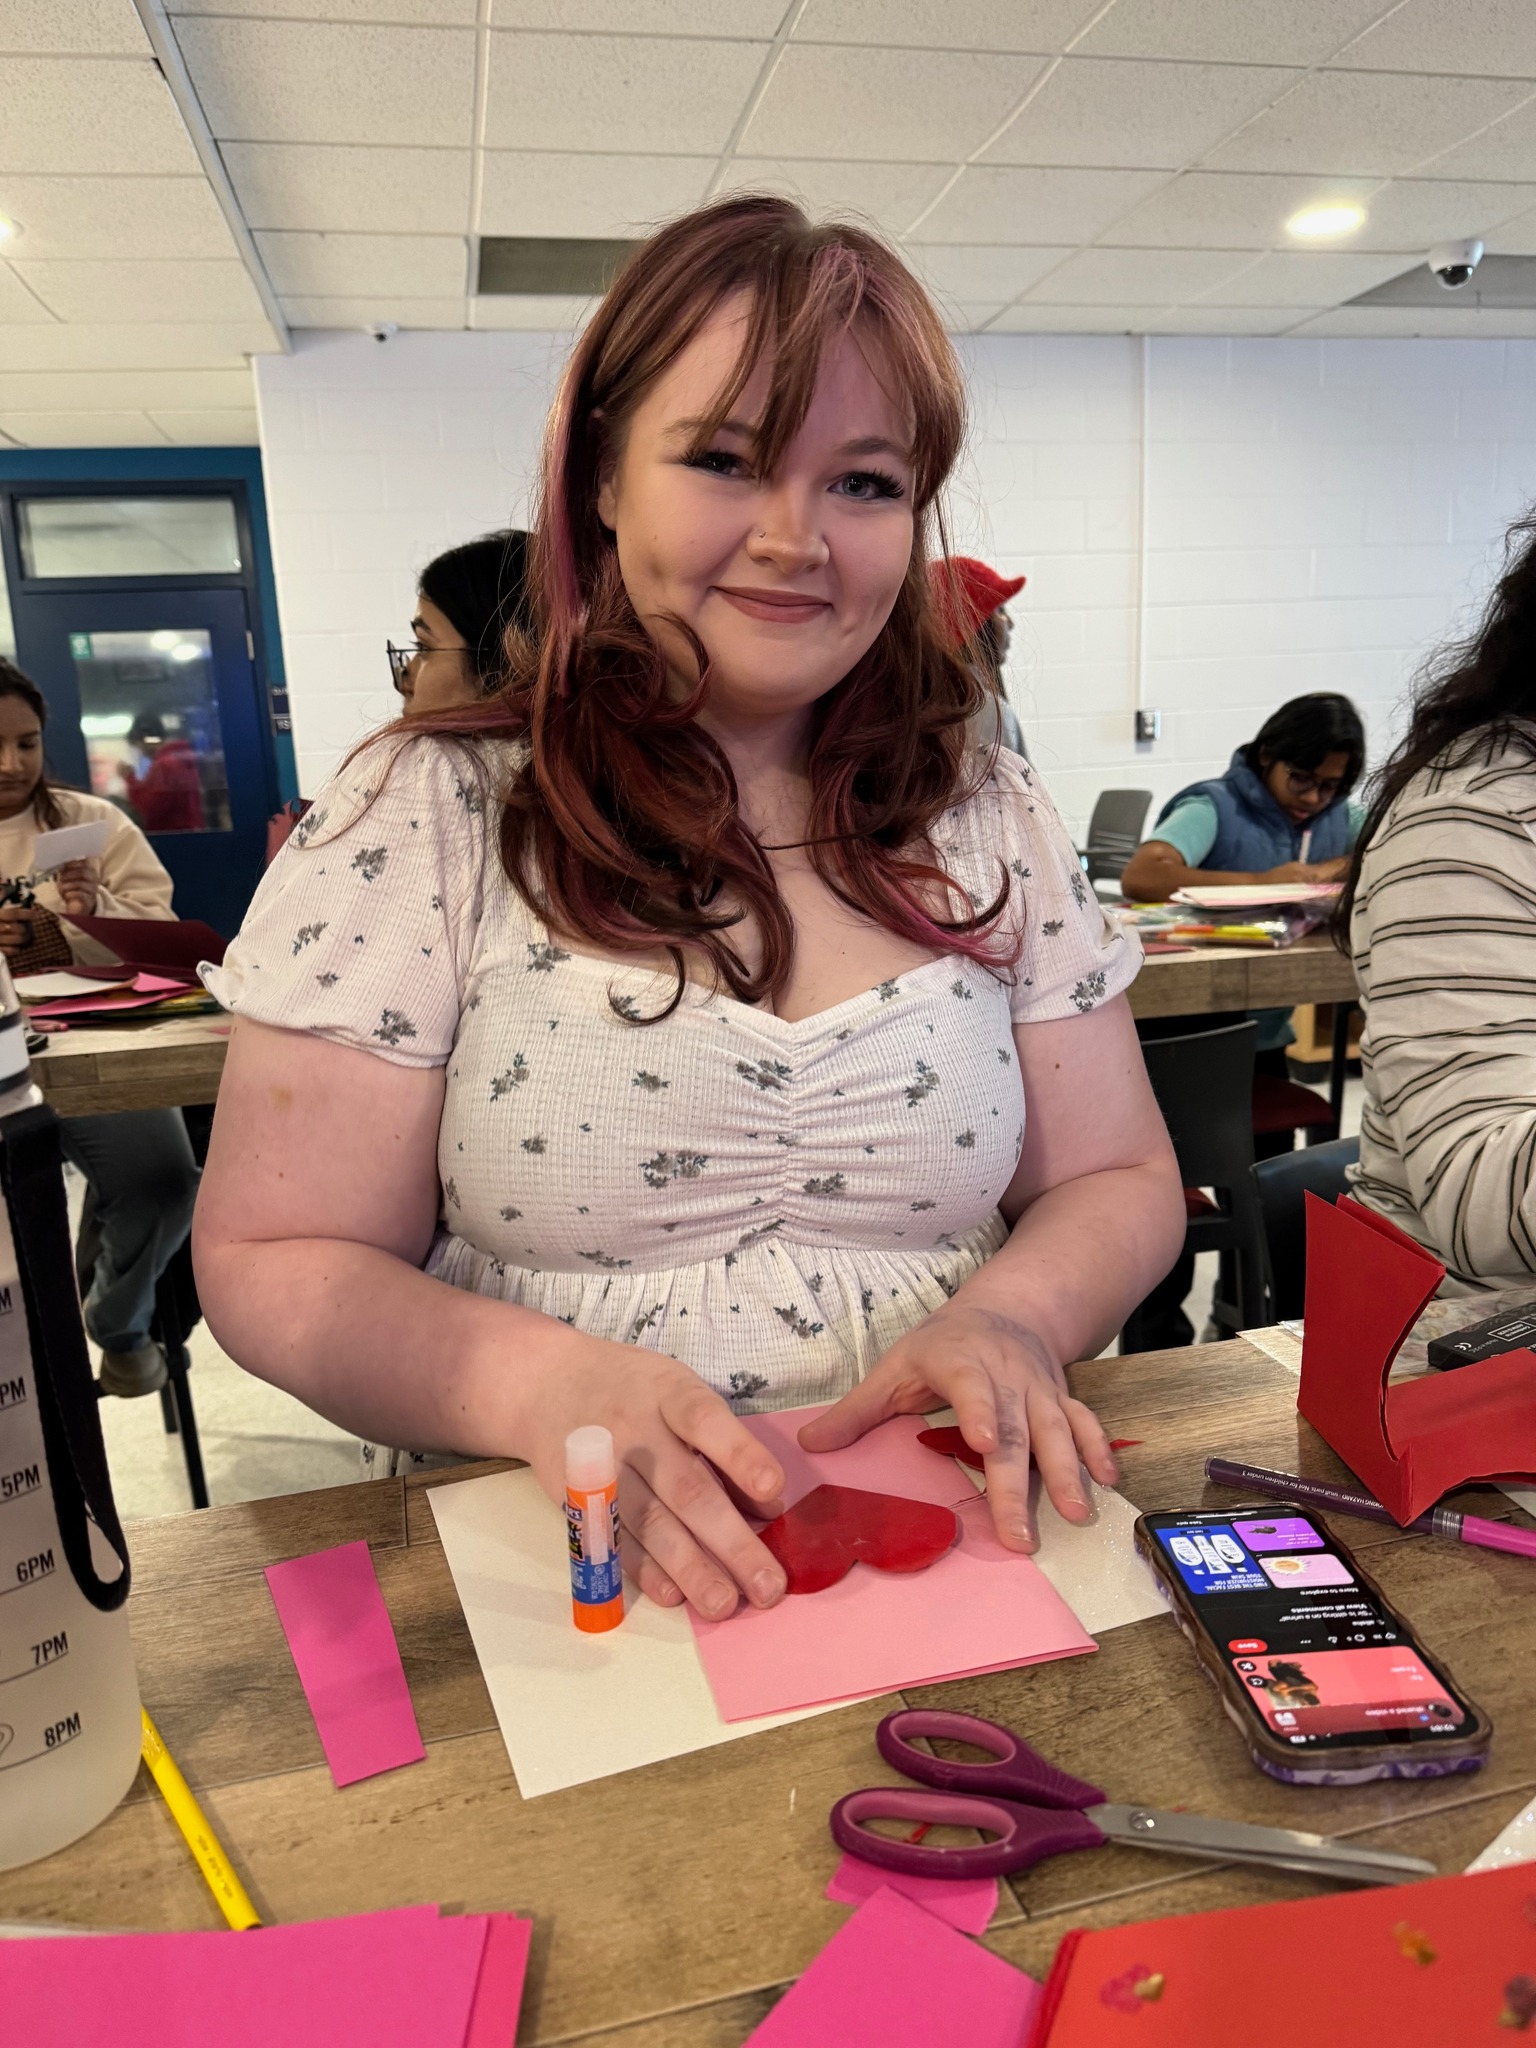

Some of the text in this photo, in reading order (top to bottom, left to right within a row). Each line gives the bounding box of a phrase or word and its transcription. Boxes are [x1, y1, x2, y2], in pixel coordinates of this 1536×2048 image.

[1, 1464, 41, 1498] 5PM
[1246, 1472, 1265, 1480] under
[1264, 1475, 1289, 1486] children
[1298, 1483, 1310, 1491] Not
[1325, 1490, 1339, 1498] small
[1341, 1493, 1365, 1504] HAZARD
[16, 1549, 55, 1583] 6PM
[31, 1631, 69, 1666] 7PM
[1365, 1708, 1389, 1716] video
[44, 1712, 82, 1748] 8PM
